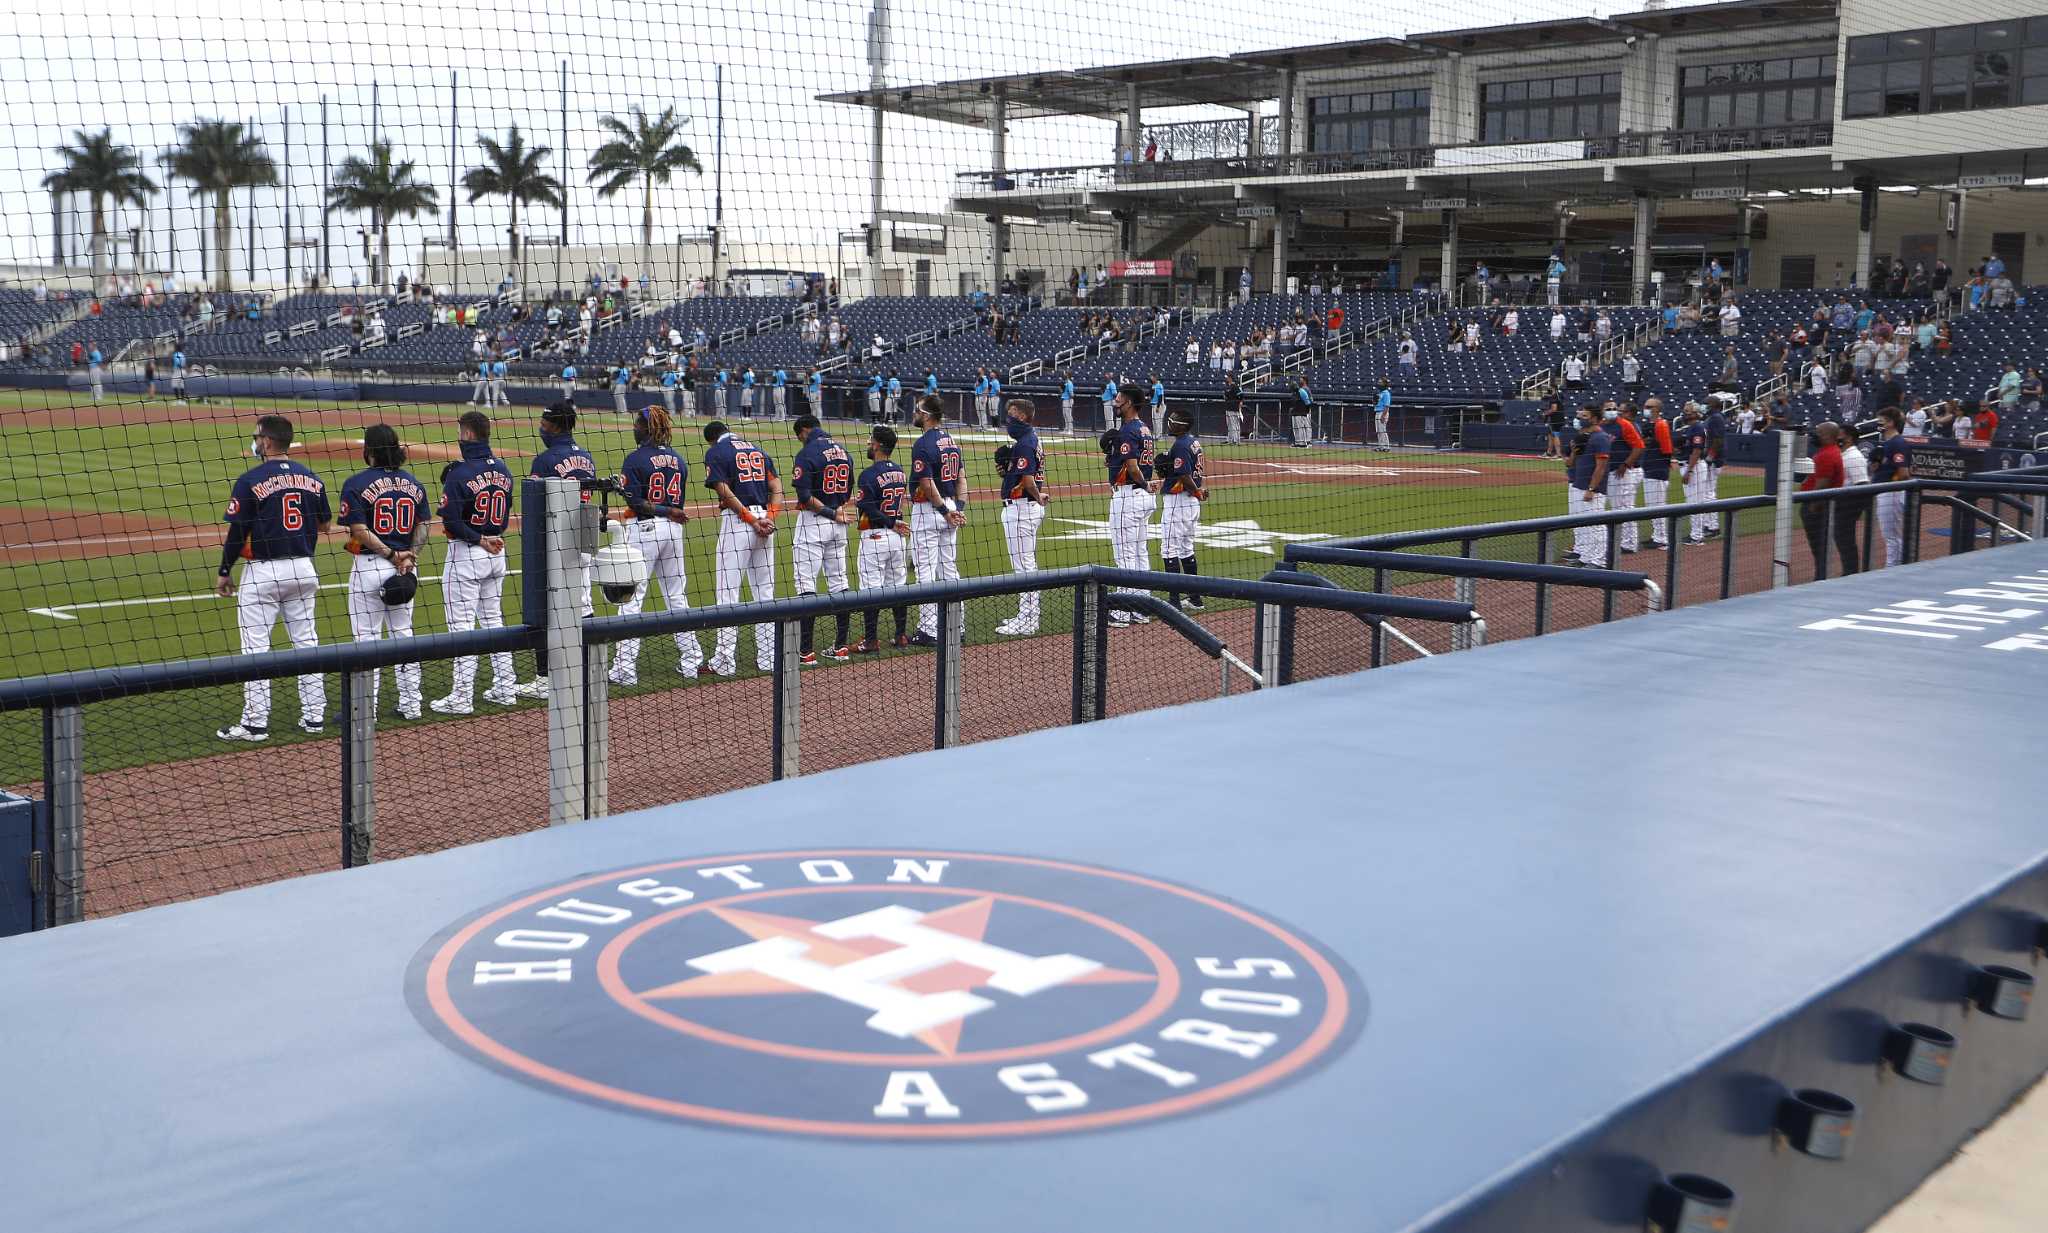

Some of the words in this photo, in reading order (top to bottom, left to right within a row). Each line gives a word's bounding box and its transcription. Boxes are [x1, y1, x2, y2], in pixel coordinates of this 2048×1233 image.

[736, 450, 766, 483] 99
[940, 451, 960, 483] 20
[1926, 454, 1965, 468] Anderson
[1937, 466, 1964, 479] Center
[647, 472, 682, 505] 84
[822, 463, 850, 495] 89
[281, 492, 303, 532] 6
[373, 497, 415, 535] 60
[470, 489, 507, 526] 90
[880, 487, 906, 517] 27
[1797, 599, 2043, 640] THE
[473, 858, 949, 986] HOUSTON
[873, 955, 1302, 1119] ASTROS
